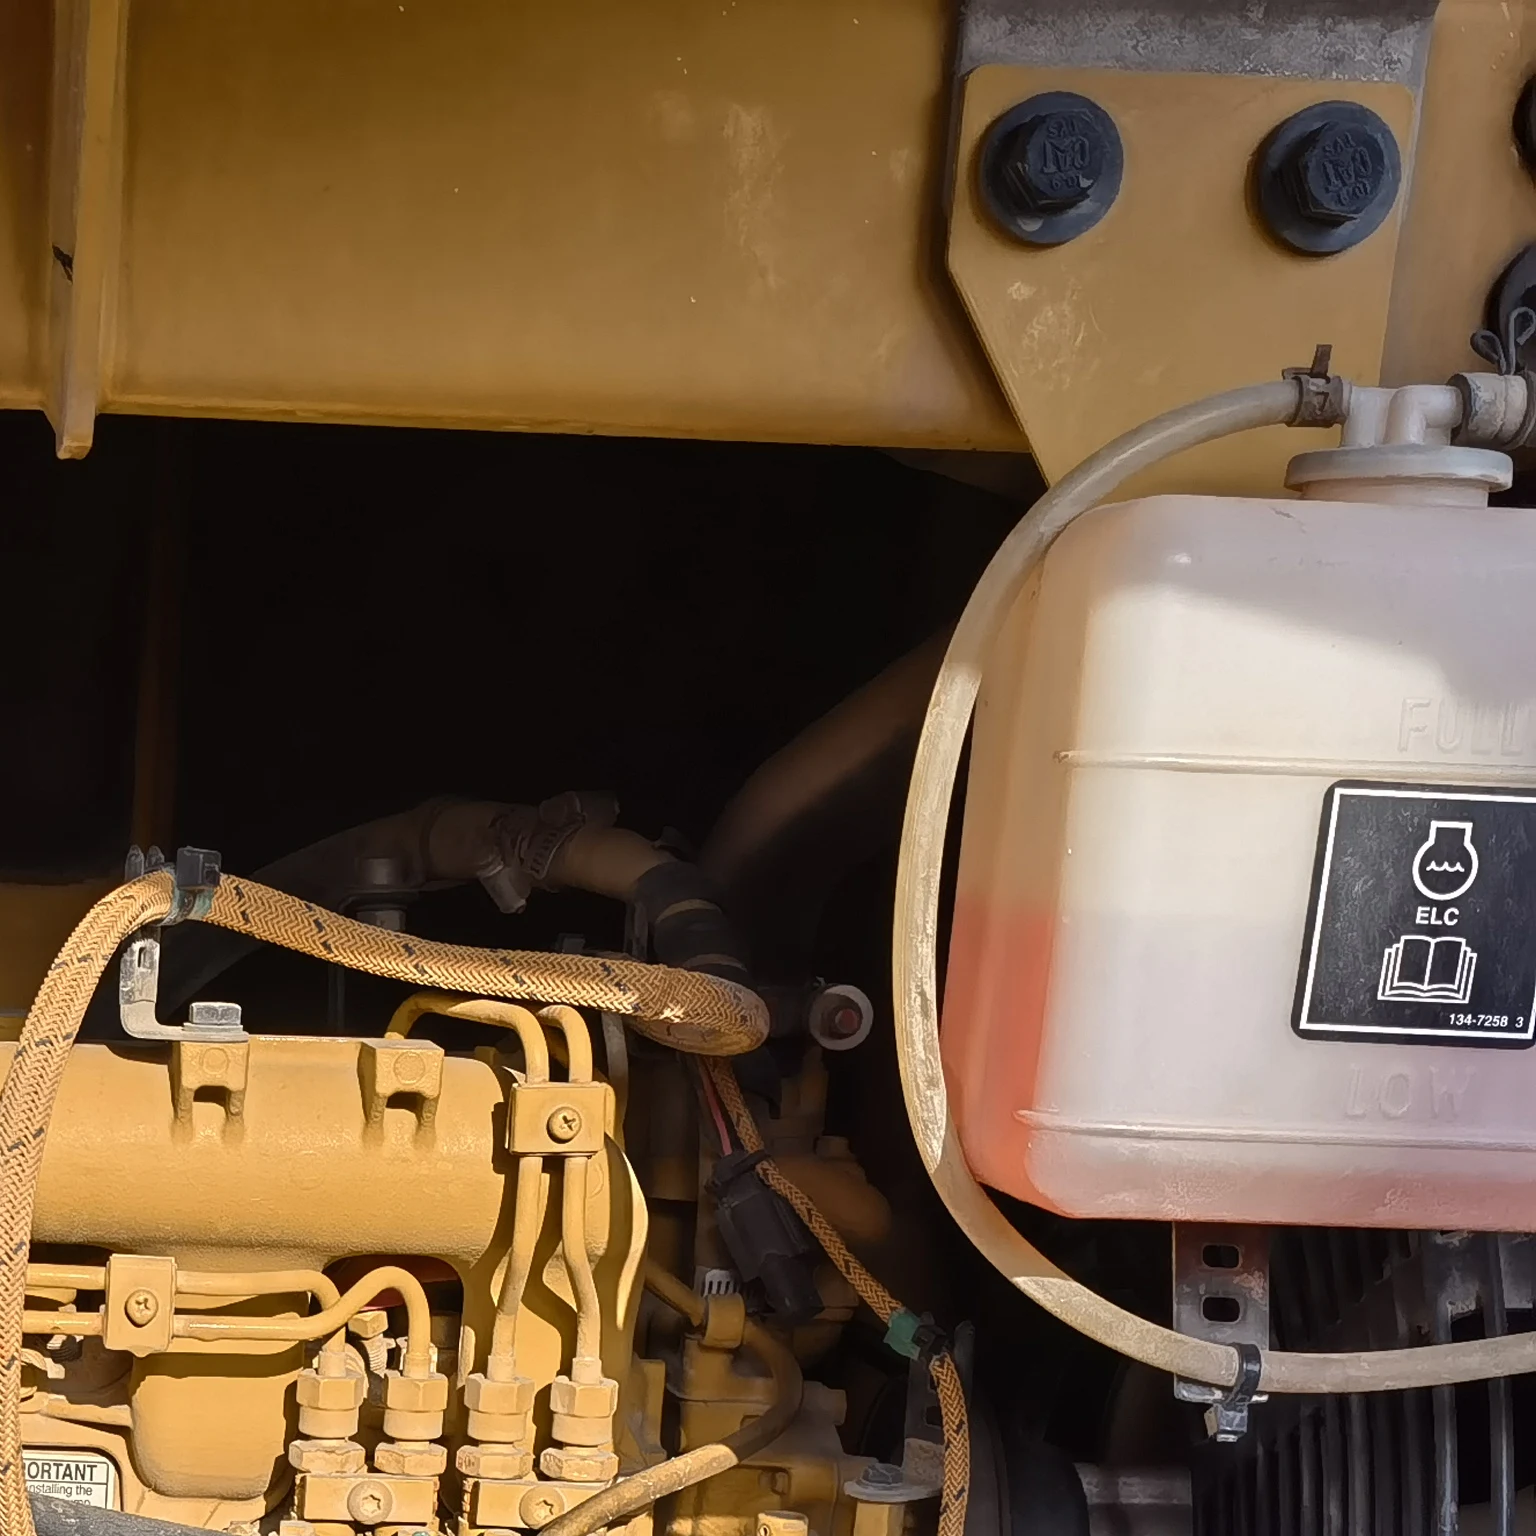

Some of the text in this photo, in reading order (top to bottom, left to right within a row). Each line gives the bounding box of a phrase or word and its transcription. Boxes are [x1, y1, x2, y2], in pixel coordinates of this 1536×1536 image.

[1396, 697, 1533, 757] FULL
[1415, 906, 1460, 927] ELC
[1448, 1012, 1524, 1030] 134-7258 3
[1344, 1062, 1477, 1119] LOW
[23, 1461, 98, 1481] ORTANT
[75, 1485, 93, 1496] the
